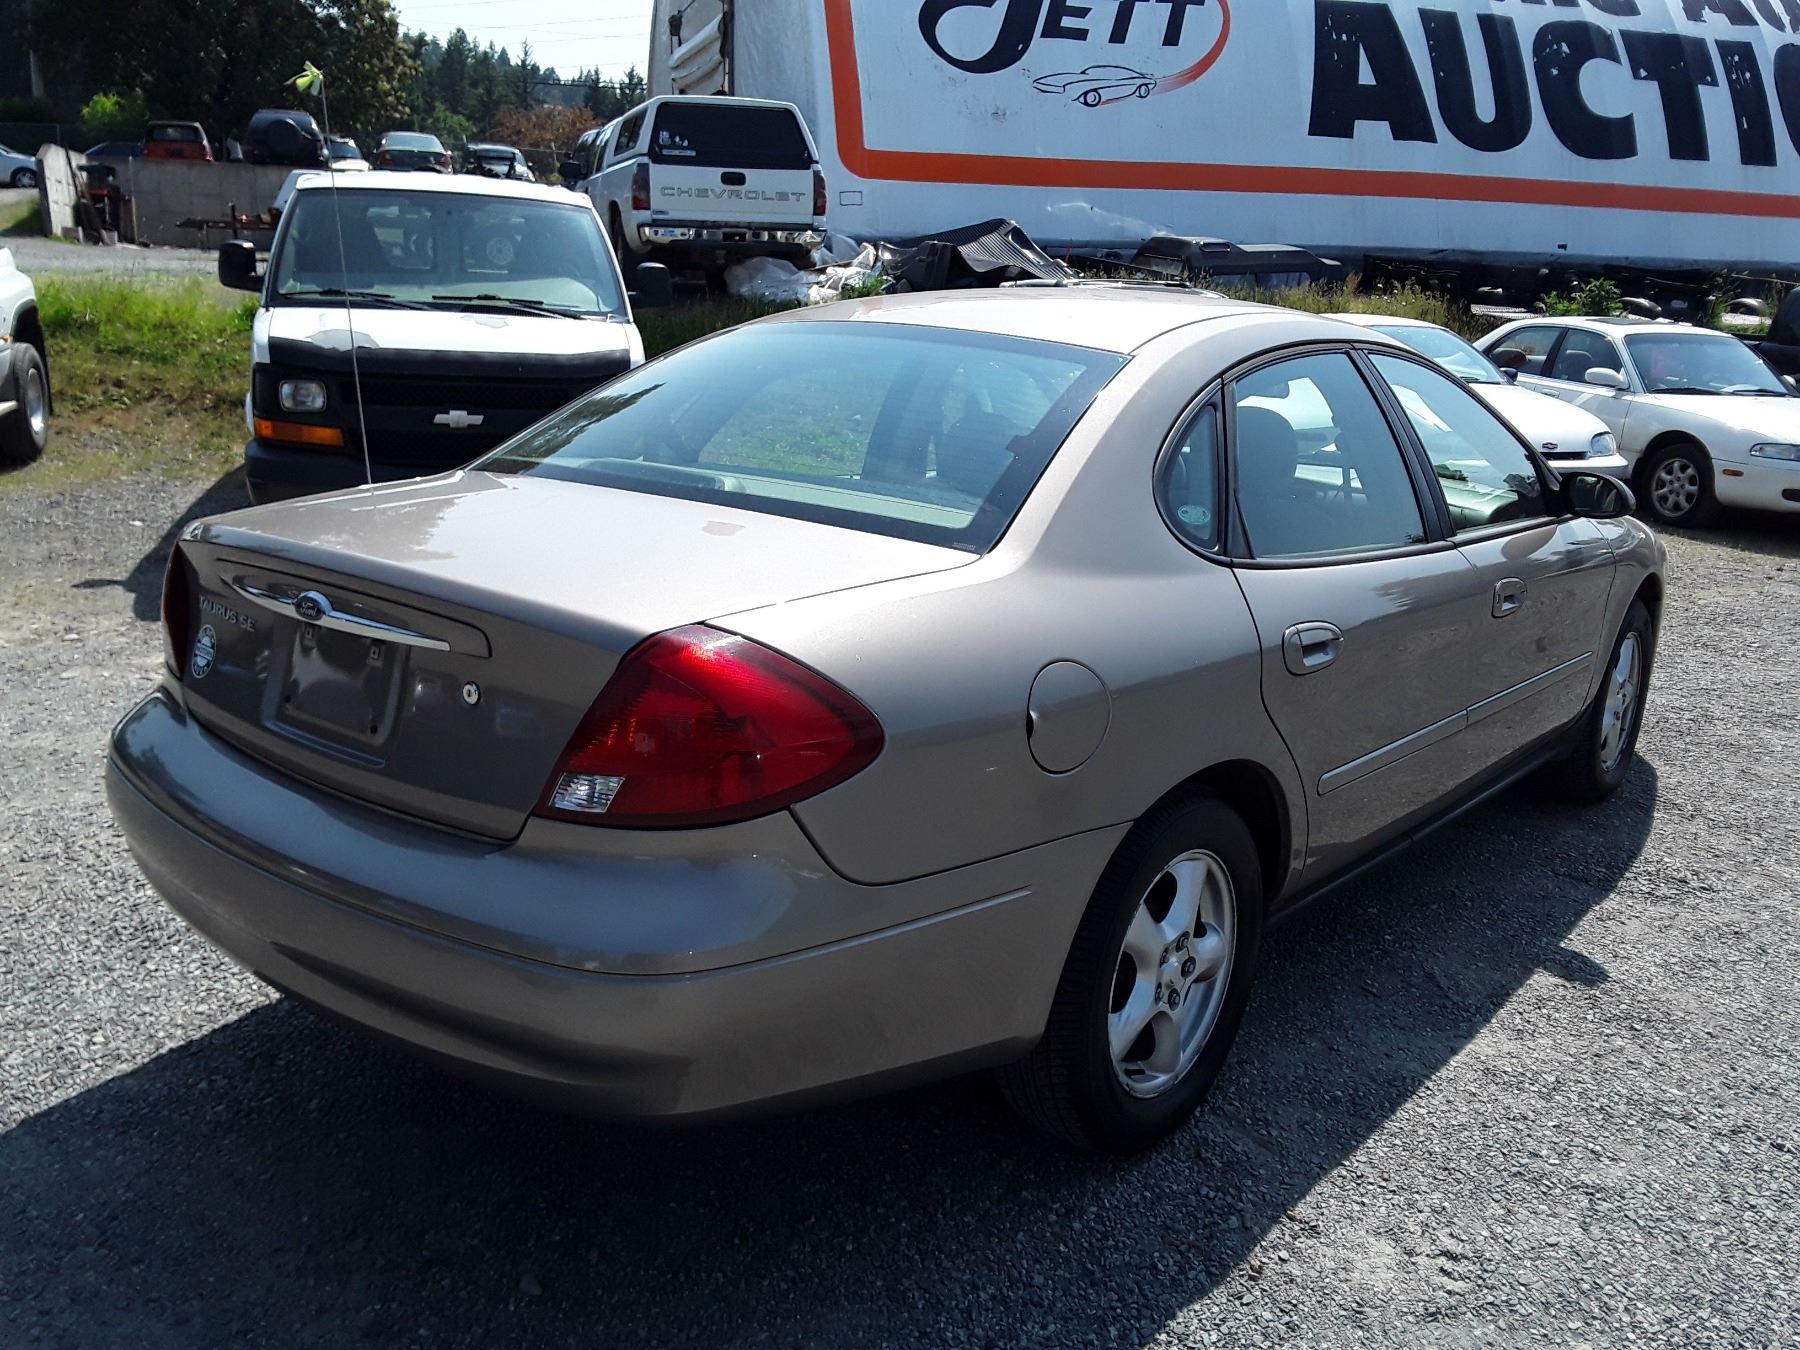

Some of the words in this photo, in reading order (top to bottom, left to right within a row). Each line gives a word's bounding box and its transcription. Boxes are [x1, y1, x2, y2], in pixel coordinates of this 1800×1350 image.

[1308, 0, 1800, 167] AUCTI
[660, 186, 806, 202] CHEVROLET
[200, 595, 238, 624] TAURUS
[239, 615, 256, 633] SE
